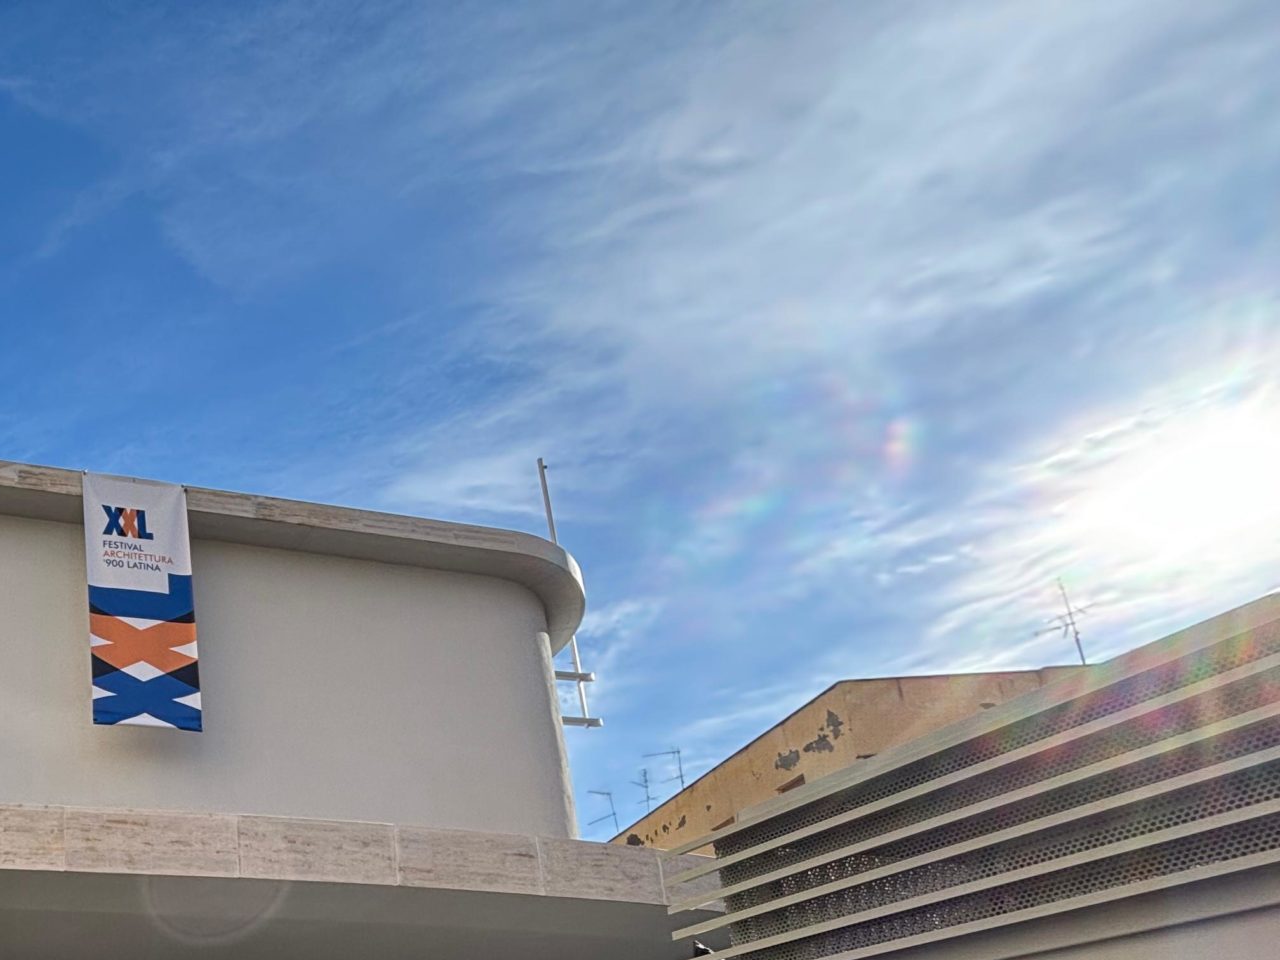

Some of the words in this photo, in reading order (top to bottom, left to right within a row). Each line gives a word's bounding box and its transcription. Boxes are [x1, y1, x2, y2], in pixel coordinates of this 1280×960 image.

[101, 504, 154, 540] XXL
[102, 540, 145, 552] FESTIVAL
[102, 550, 175, 565] ARCHITETTURA
[127, 560, 162, 572] LATINA
